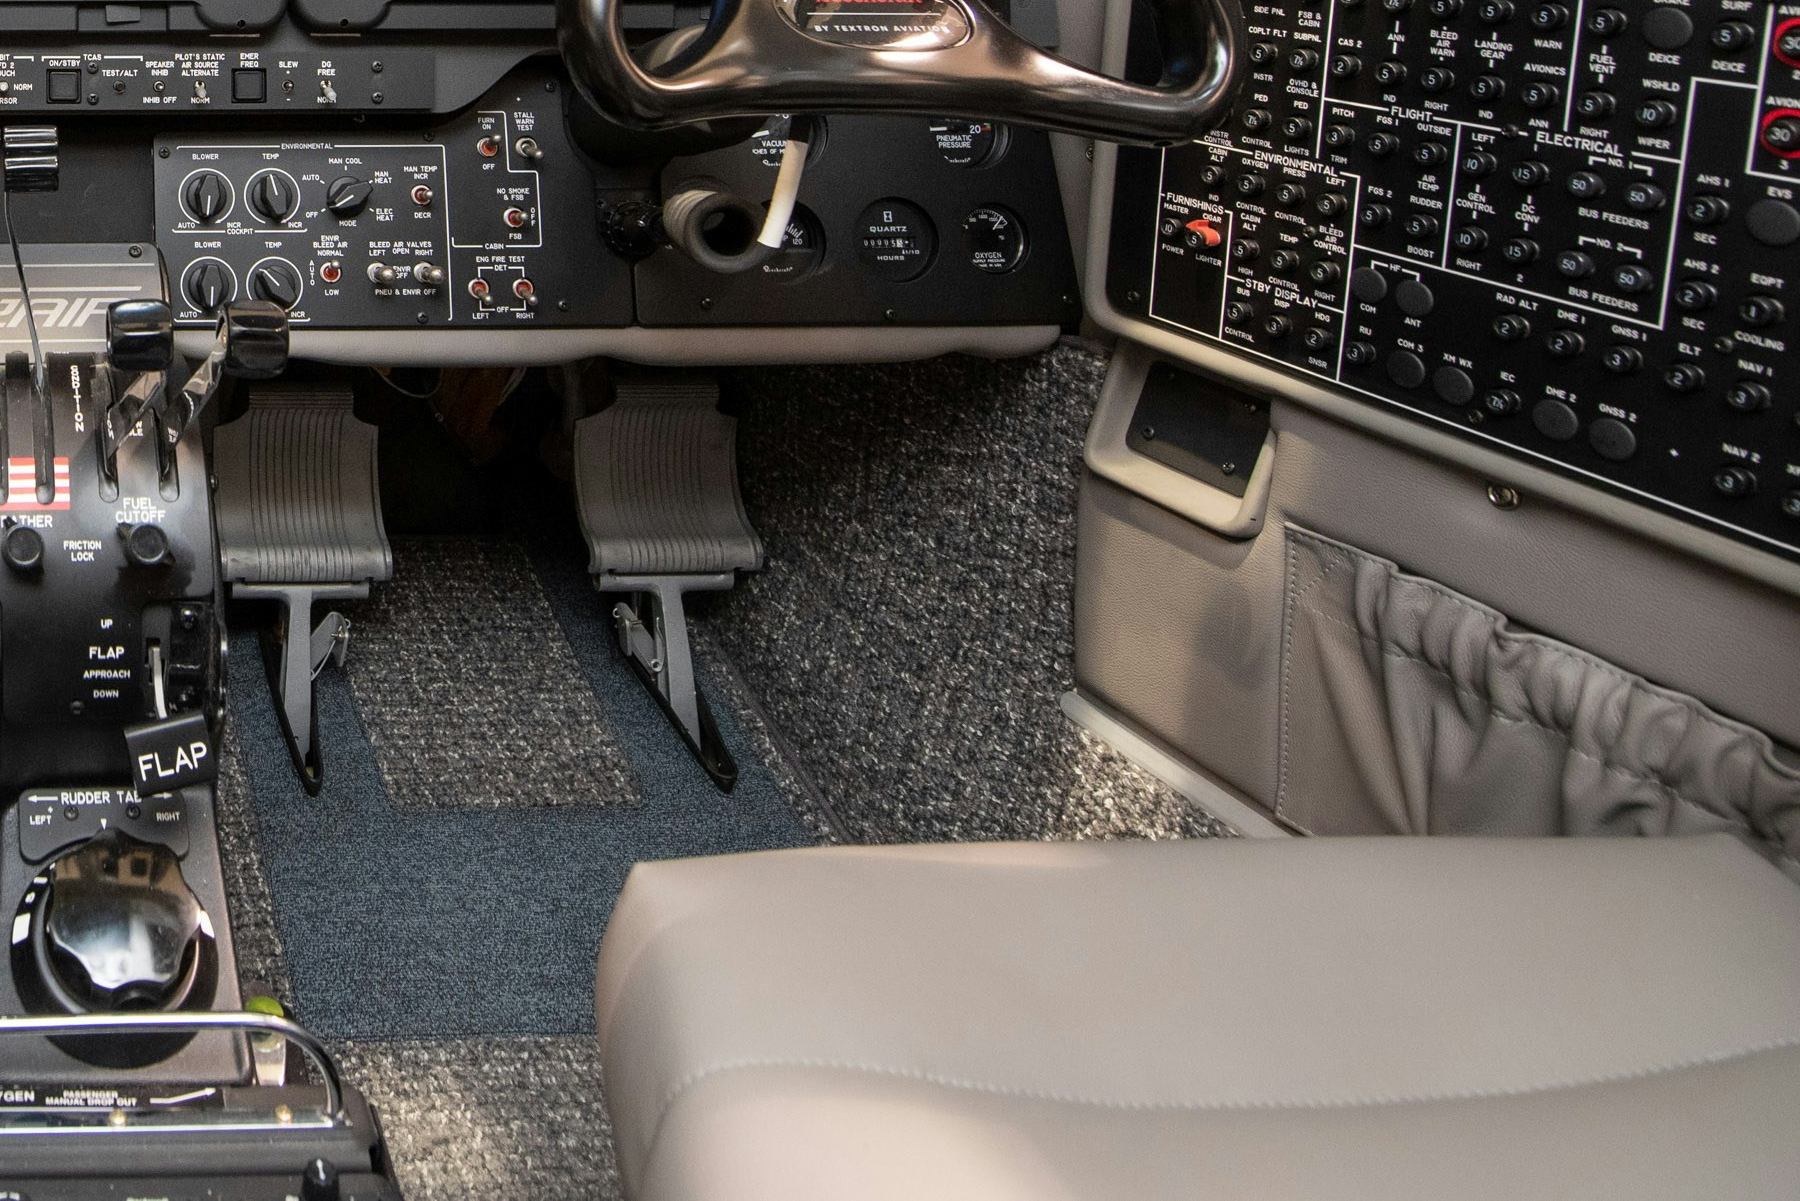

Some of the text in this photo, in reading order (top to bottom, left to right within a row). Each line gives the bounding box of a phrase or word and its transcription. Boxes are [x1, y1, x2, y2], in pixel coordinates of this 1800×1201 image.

[1391, 107, 1433, 122] FLIGHT
[1536, 132, 1623, 157] ELECTRICAL
[1255, 151, 1337, 176] ENVIRONMENTAL
[1167, 192, 1225, 215] FURNISHINGS
[1578, 207, 1649, 230] BUS FEEDERS
[1245, 279, 1318, 308] STBY DISPLAY
[123, 498, 156, 510] FUEL
[116, 510, 165, 523] CUTOFF
[89, 647, 124, 659] FLAP
[83, 670, 130, 678] APPROACH
[93, 690, 119, 698] DOWN
[138, 741, 207, 782] FLAP
[61, 791, 110, 805] RUDDER
